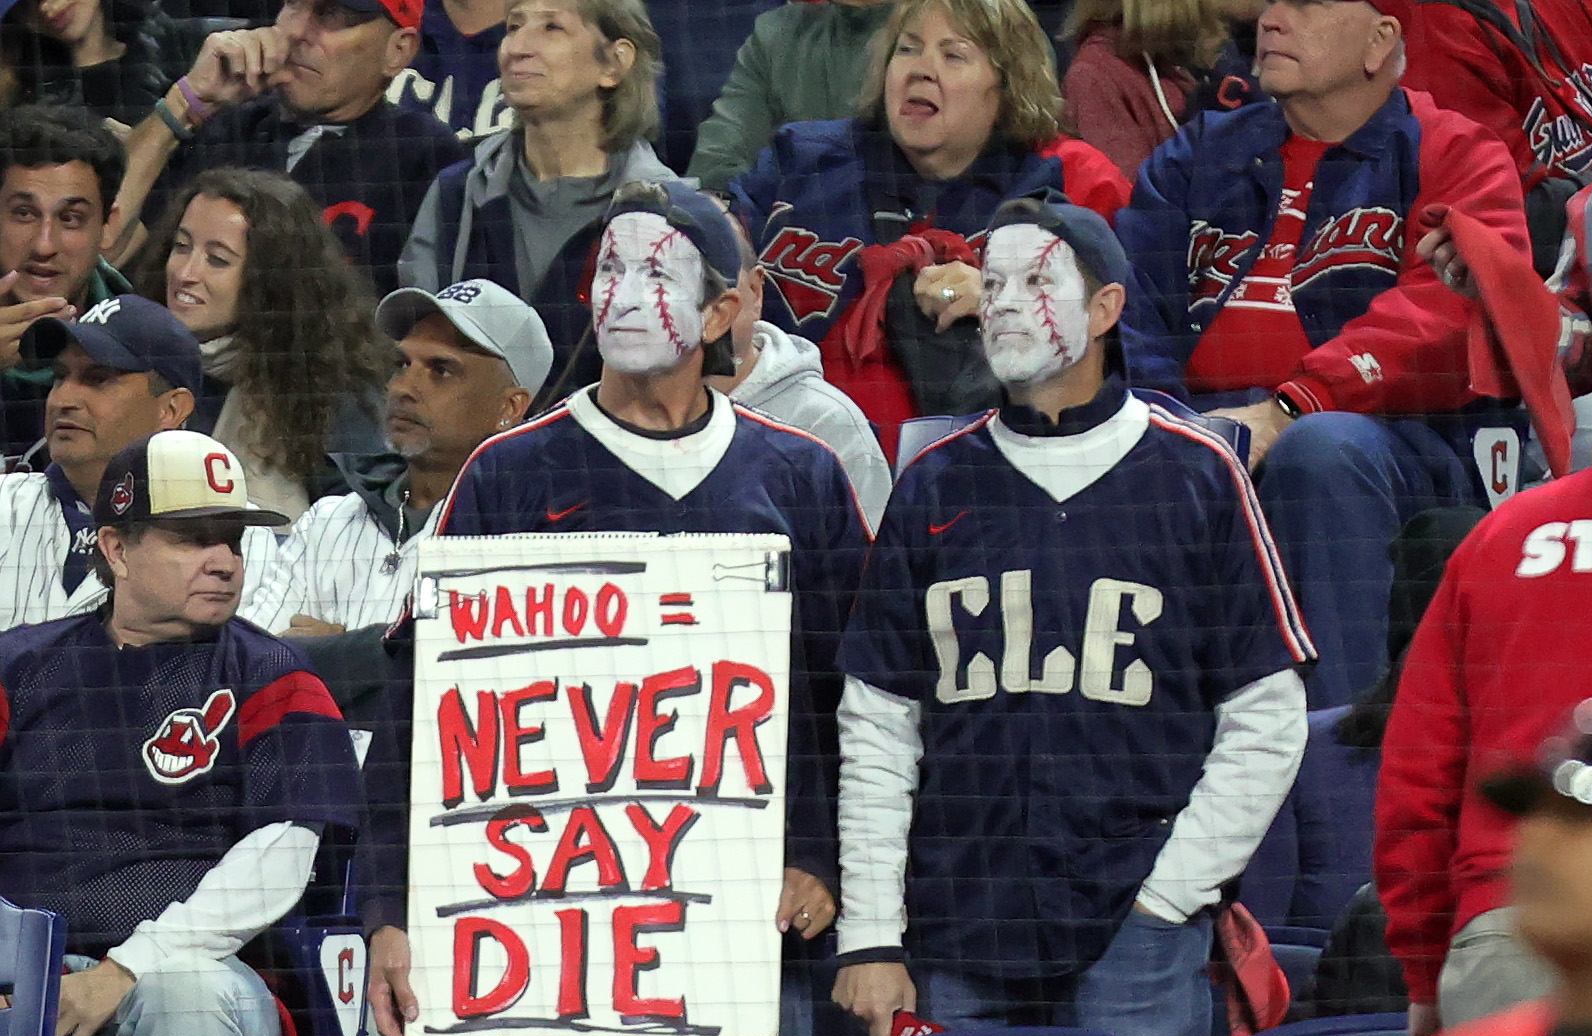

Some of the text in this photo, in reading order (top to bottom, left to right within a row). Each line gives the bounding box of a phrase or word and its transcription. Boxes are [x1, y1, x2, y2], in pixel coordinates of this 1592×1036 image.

[1217, 75, 1250, 108] C
[204, 452, 234, 494] C
[1491, 441, 1508, 494] C
[449, 582, 628, 644] WAHOO
[926, 569, 1164, 706] CLE
[437, 660, 775, 808] NEVER
[472, 804, 701, 899] SAY
[338, 948, 354, 1004] C
[452, 899, 690, 1024] DIE
